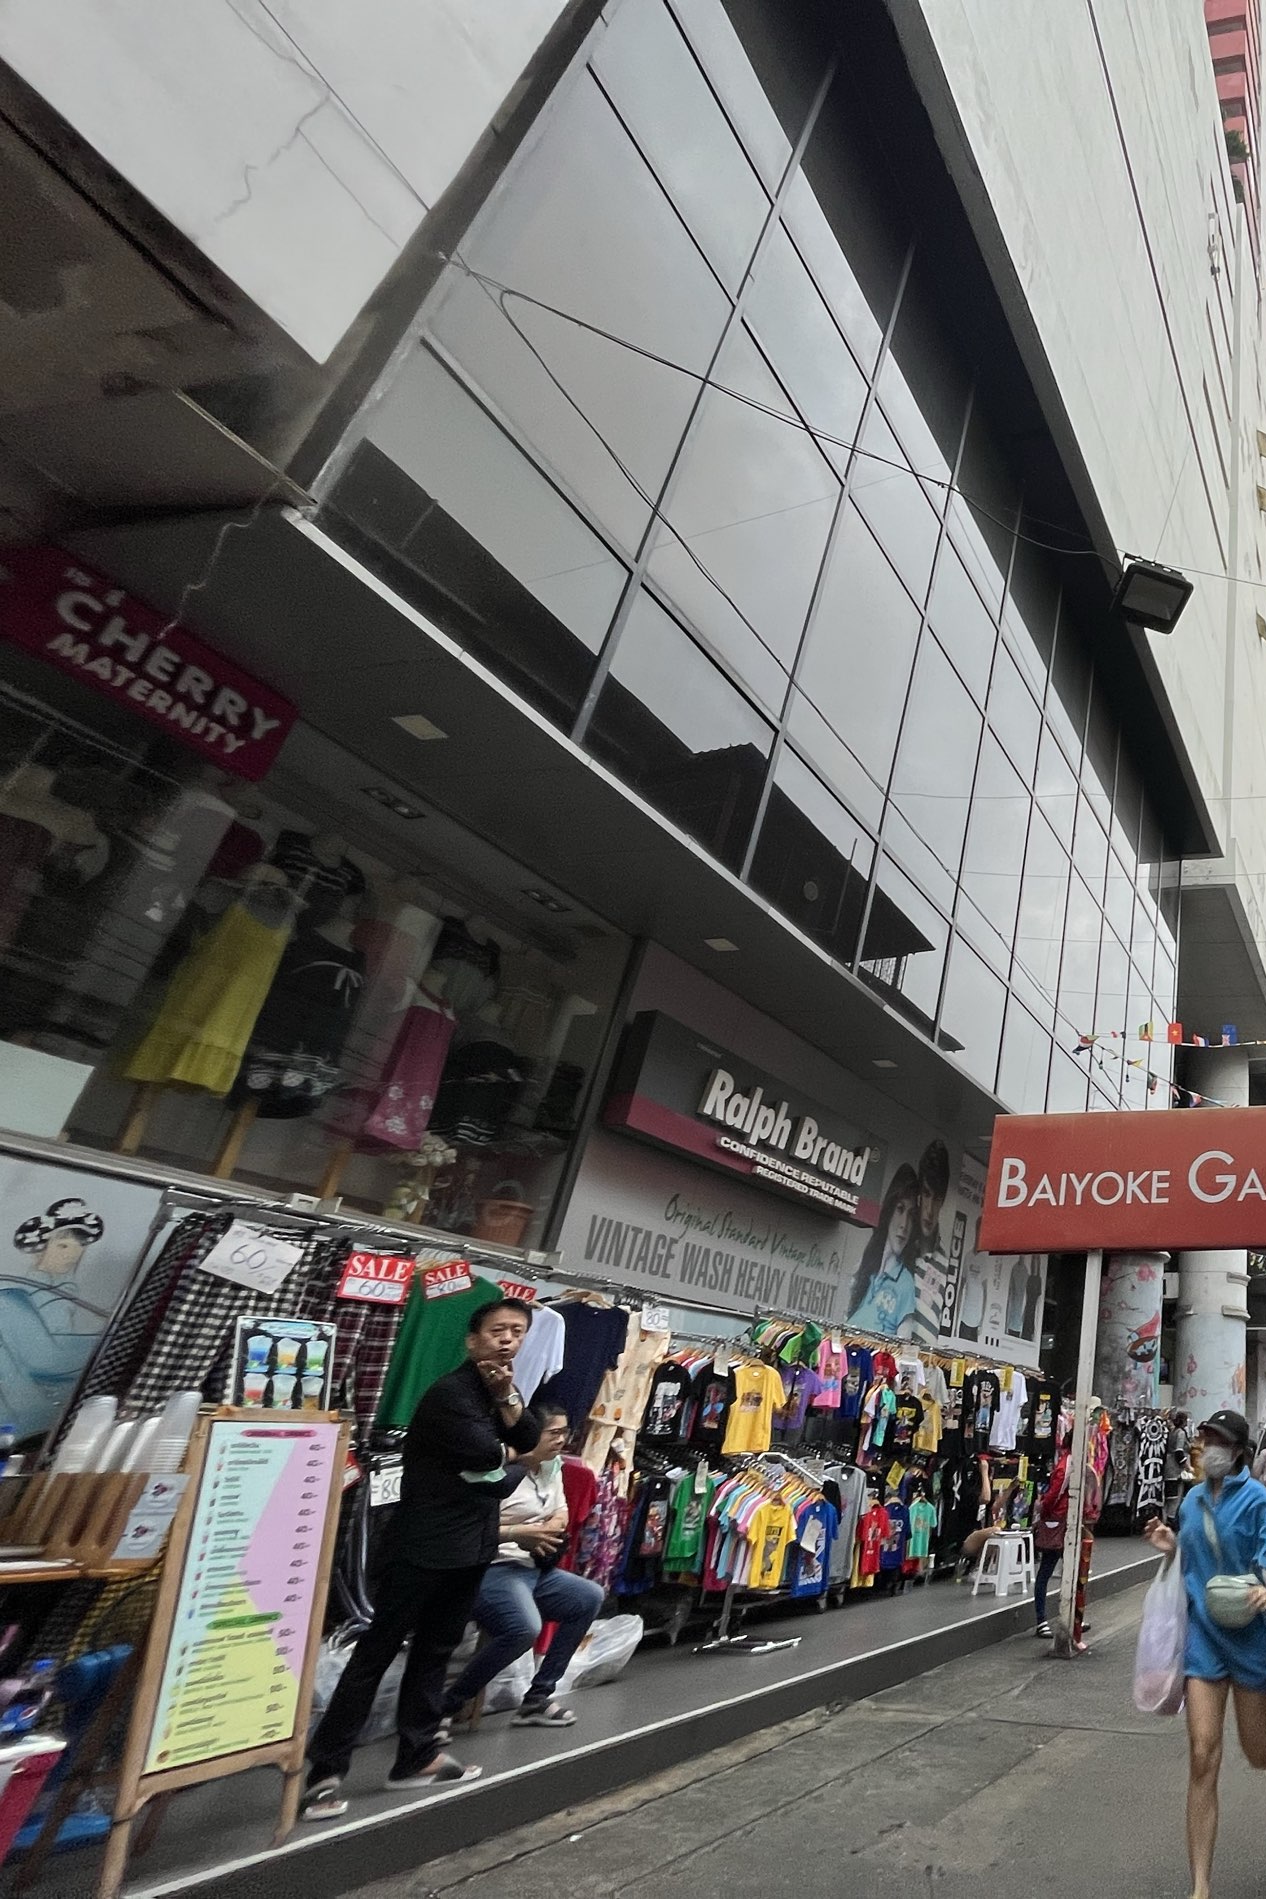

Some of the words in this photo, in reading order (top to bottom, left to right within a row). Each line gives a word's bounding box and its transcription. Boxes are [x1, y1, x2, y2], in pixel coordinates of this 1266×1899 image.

[47, 633, 246, 754] MATERNITY
[56, 591, 280, 740] CHERRY
[701, 1068, 793, 1151] Ralph
[793, 1116, 871, 1187] Brand
[720, 1136, 801, 1180] CONFIDENCE
[800, 1169, 860, 1205] REPUTABLE
[755, 1165, 809, 1195] REGISTERED
[808, 1186, 835, 1206] TRADE
[833, 1199, 858, 1215] MARK
[997, 1157, 1171, 1208] BAIYOKE
[664, 1193, 717, 1240] Original
[348, 1254, 412, 1282] SALE
[424, 1263, 468, 1285] SALE
[500, 1281, 535, 1300] SALE
[584, 1214, 679, 1280] VINTAGE
[679, 1241, 736, 1294] WASH
[733, 1257, 788, 1306] HEAVY
[785, 1270, 839, 1320] WEIGHT
[941, 1217, 965, 1328] POLICE
